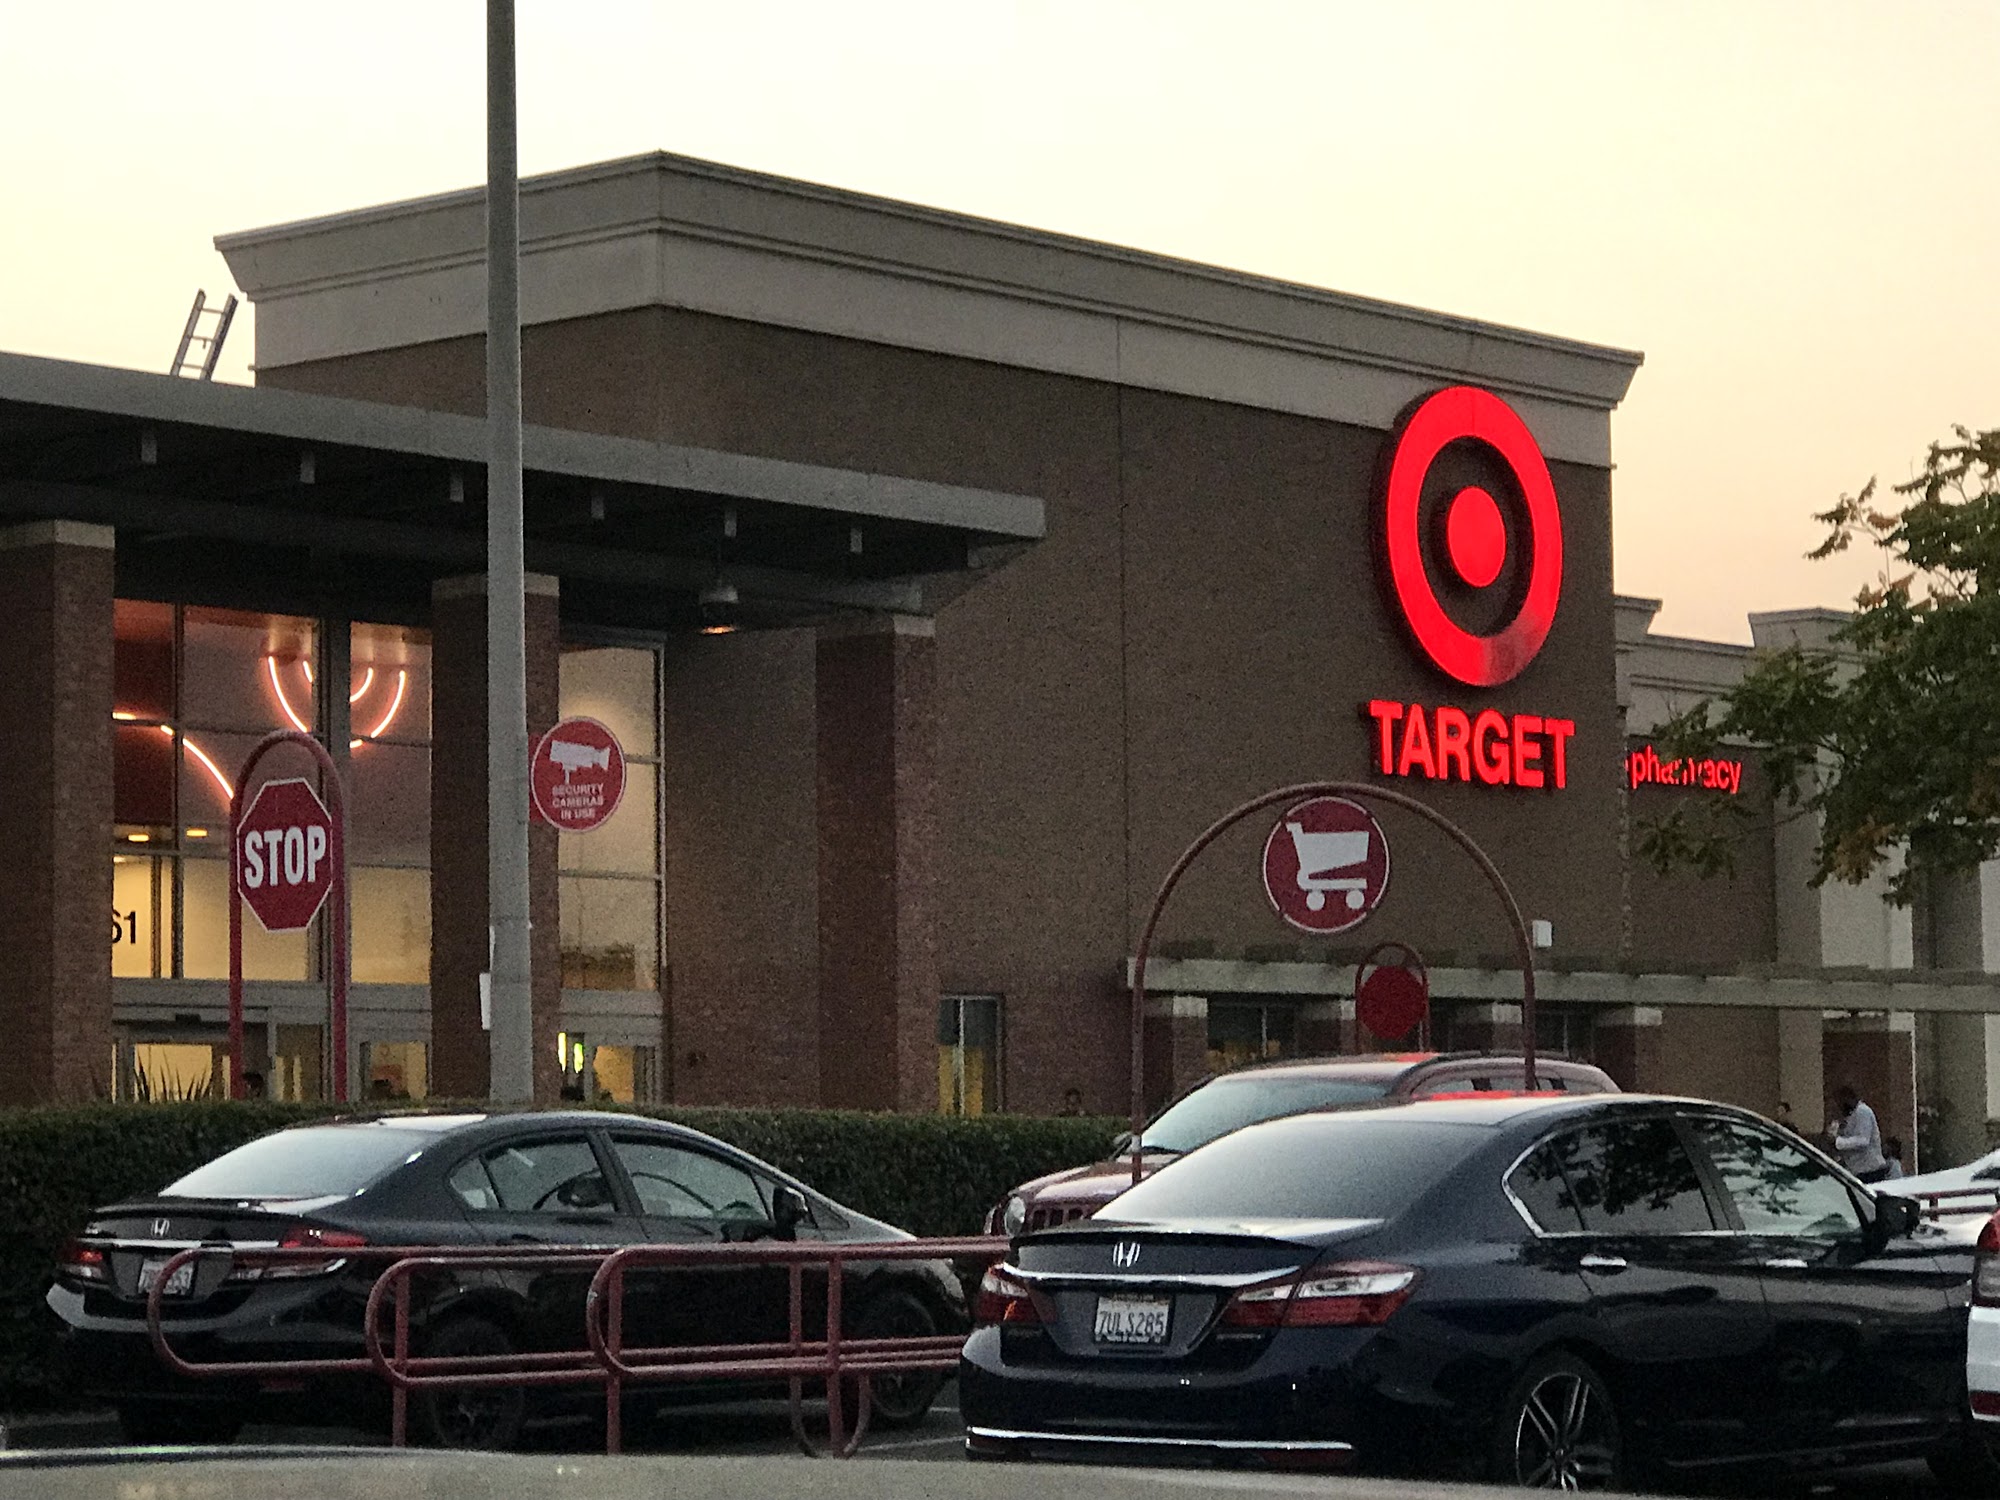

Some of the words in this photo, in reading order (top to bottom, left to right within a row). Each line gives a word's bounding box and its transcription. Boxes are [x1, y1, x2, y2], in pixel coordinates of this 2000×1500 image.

[1369, 700, 1576, 789] TARGET
[552, 784, 604, 796] SECURITY
[552, 795, 604, 808] CAMERAS
[560, 809, 572, 820] IN
[574, 808, 596, 819] USE
[244, 825, 326, 889] STOP
